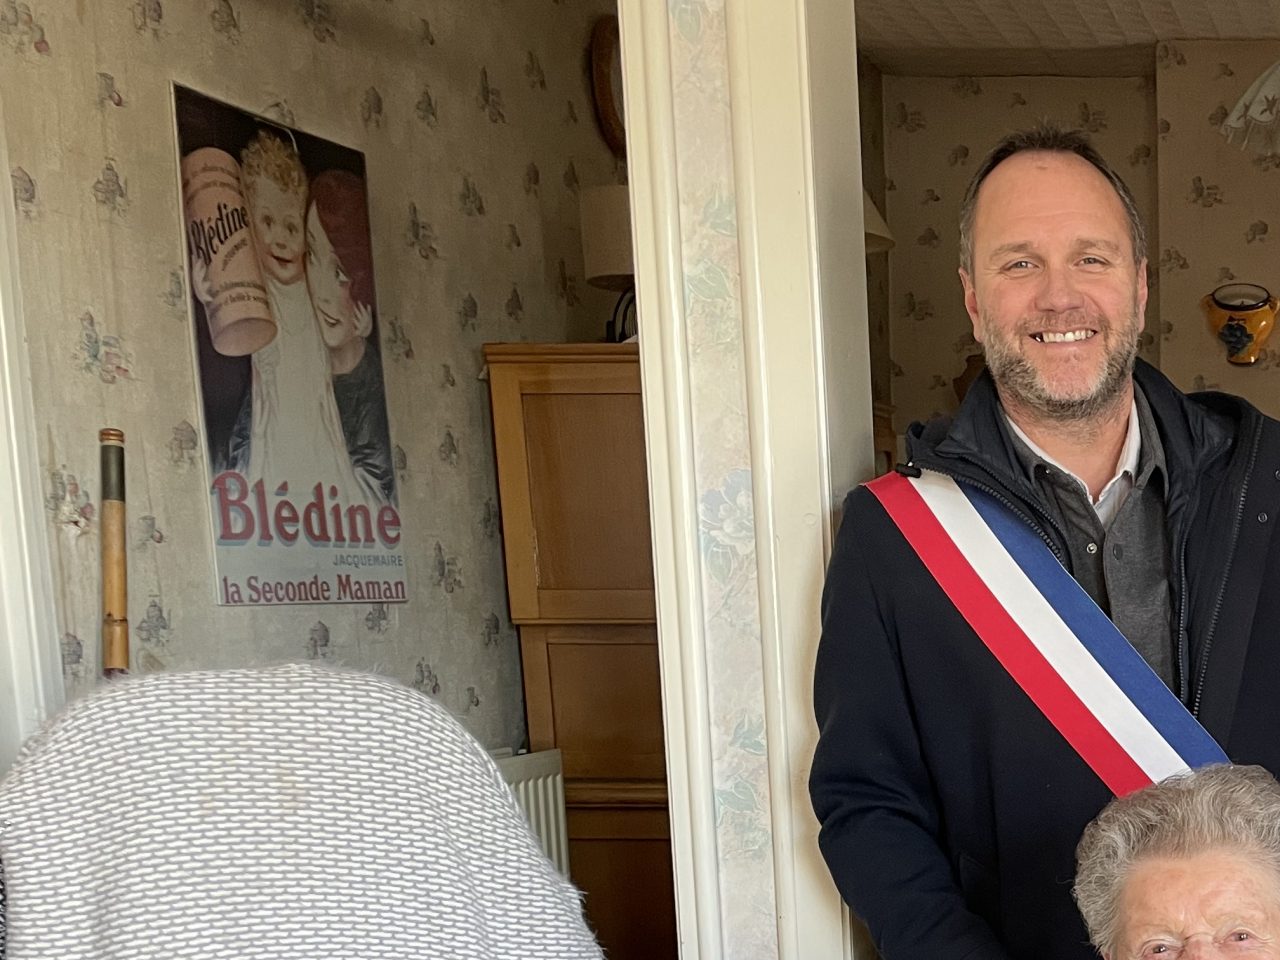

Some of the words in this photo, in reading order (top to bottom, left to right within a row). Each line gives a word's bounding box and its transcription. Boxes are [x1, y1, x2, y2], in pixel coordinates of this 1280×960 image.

[211, 470, 402, 547] Blédine
[333, 554, 404, 569] JACQUEMAIRE
[223, 575, 243, 604] la
[247, 575, 331, 603] Seconde
[336, 574, 406, 600] Maman
